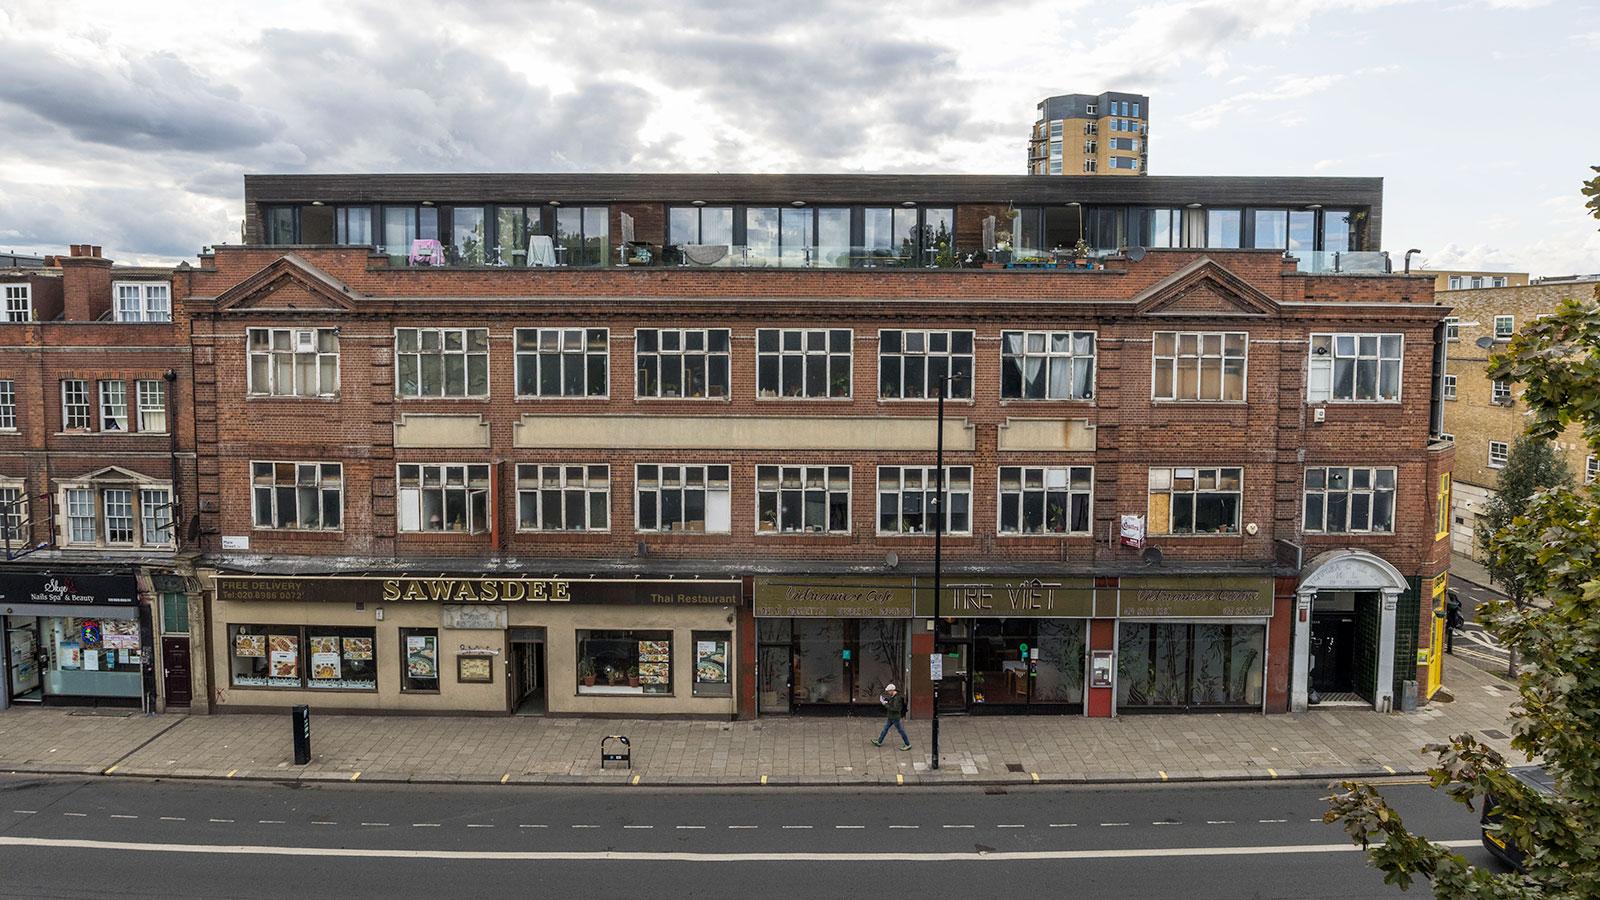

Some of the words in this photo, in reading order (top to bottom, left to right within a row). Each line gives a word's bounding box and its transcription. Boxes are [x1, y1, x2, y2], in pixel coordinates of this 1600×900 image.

[222, 582, 250, 591] FREE
[252, 583, 303, 591] DELIVERY
[382, 579, 571, 602] SAWASDEE
[49, 594, 62, 603] Spa
[71, 595, 95, 603] Beauty
[650, 594, 674, 604] Thai
[677, 594, 737, 604] Restaurant
[946, 583, 994, 610] TRE
